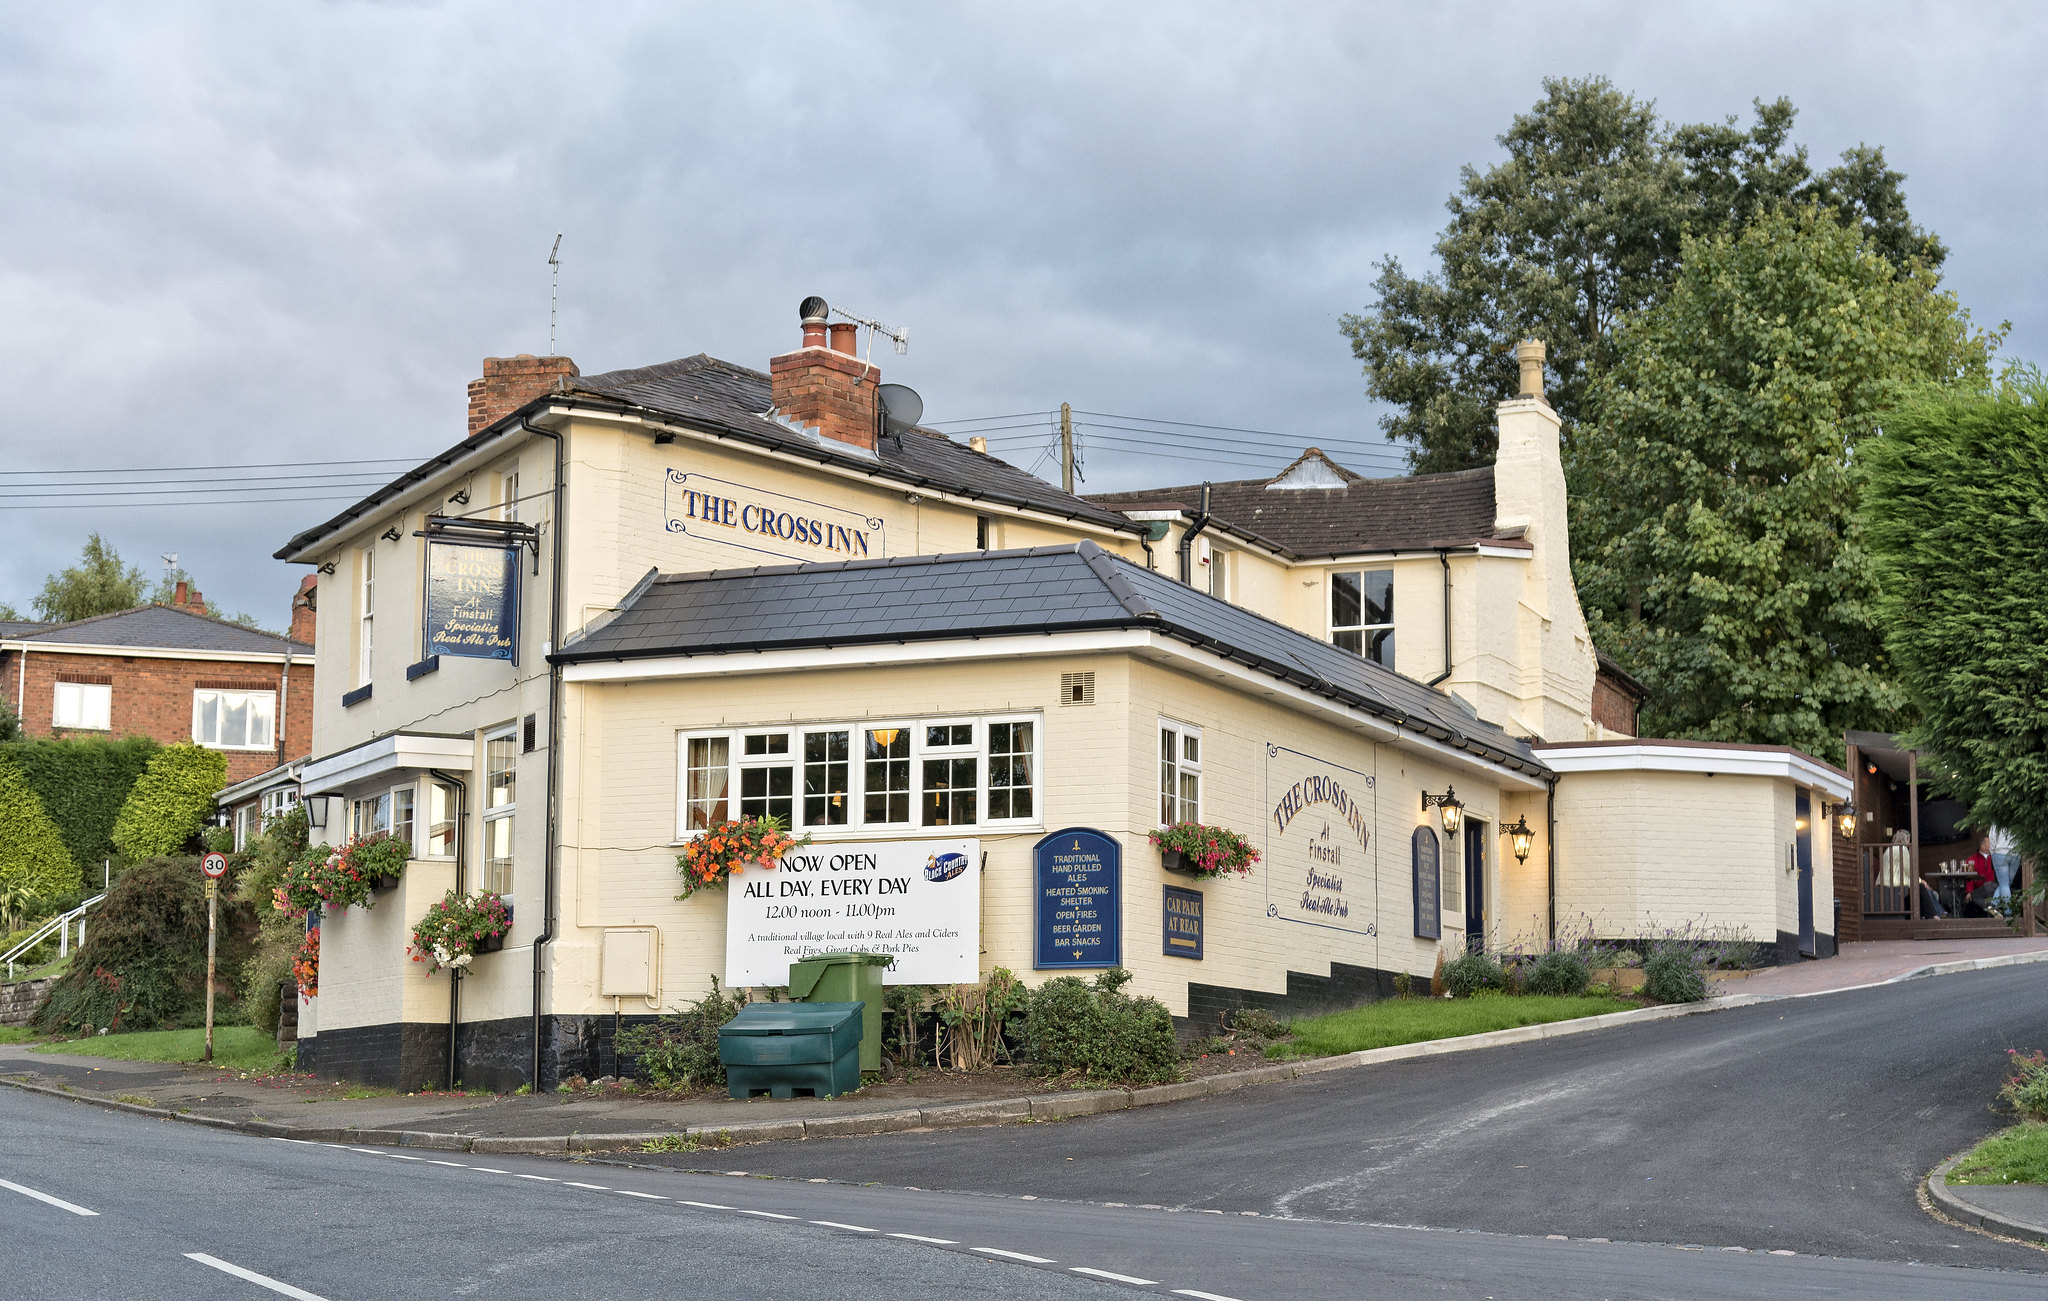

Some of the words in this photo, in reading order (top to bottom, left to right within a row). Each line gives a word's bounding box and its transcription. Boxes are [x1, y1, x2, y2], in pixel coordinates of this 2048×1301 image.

[682, 489, 737, 529] THE
[741, 504, 823, 547] CROSS
[825, 523, 870, 558] INN
[464, 551, 485, 561] THE
[446, 561, 503, 578] CROSS
[457, 578, 490, 593] INN
[465, 596, 481, 609] At
[453, 606, 493, 620] Finstall
[445, 619, 499, 633] Specialist
[433, 631, 461, 645] Real
[462, 634, 484, 645] Ale
[486, 635, 511, 647] Pub
[1273, 782, 1303, 836] THE
[1304, 775, 1348, 817] CROSS
[1347, 798, 1371, 854] INN
[1320, 820, 1330, 841] At
[1053, 854, 1100, 863] TRADITIONAL
[1309, 838, 1341, 866] Finstall
[206, 859, 224, 870] 30
[779, 856, 824, 873] NOW
[829, 853, 877, 871] OPEN
[924, 866, 943, 881] BLACK
[943, 854, 968, 874] COUNTRY
[1052, 865, 1073, 873] HAND
[1074, 863, 1102, 872] PULLED
[946, 866, 963, 880] ALES
[1067, 873, 1087, 882] ALES
[1306, 867, 1343, 892] Specialist
[744, 881, 774, 898] ALL
[780, 880, 814, 898] DAY,
[821, 878, 873, 896] EVERY
[878, 877, 911, 895] DAY
[1046, 887, 1076, 896] HEATED
[1077, 886, 1109, 895] SMOKING
[1060, 897, 1093, 906] SHELTER
[1167, 897, 1181, 913] CAR
[1181, 900, 1200, 916] PARK
[1300, 891, 1320, 912] Real
[1319, 896, 1334, 915] Ale
[1333, 898, 1349, 918] Pub
[765, 905, 798, 919] 12.00
[800, 908, 832, 918] noon
[846, 903, 896, 920] 11.00pm
[1055, 911, 1075, 919] OPEN
[1076, 910, 1097, 919] FIRES
[1053, 925, 1071, 933] BEER
[1072, 924, 1102, 933] GARDEN
[1167, 916, 1179, 931] AT
[1179, 917, 1200, 935] REAR
[748, 933, 755, 941] A
[757, 932, 798, 942] traditional
[800, 931, 825, 942] village
[826, 930, 845, 940] local
[848, 930, 865, 940] with
[867, 931, 873, 940] 9
[875, 930, 893, 939] Real
[894, 929, 913, 939] Ales
[915, 929, 930, 938] and
[932, 928, 959, 938] Ciders
[1055, 938, 1070, 947] BAR
[1071, 937, 1101, 946] SNACKS
[784, 945, 801, 955] Real
[826, 944, 849, 953] Great
[871, 944, 881, 953] &
[882, 943, 900, 953] Pork
[902, 943, 920, 953] Pies
